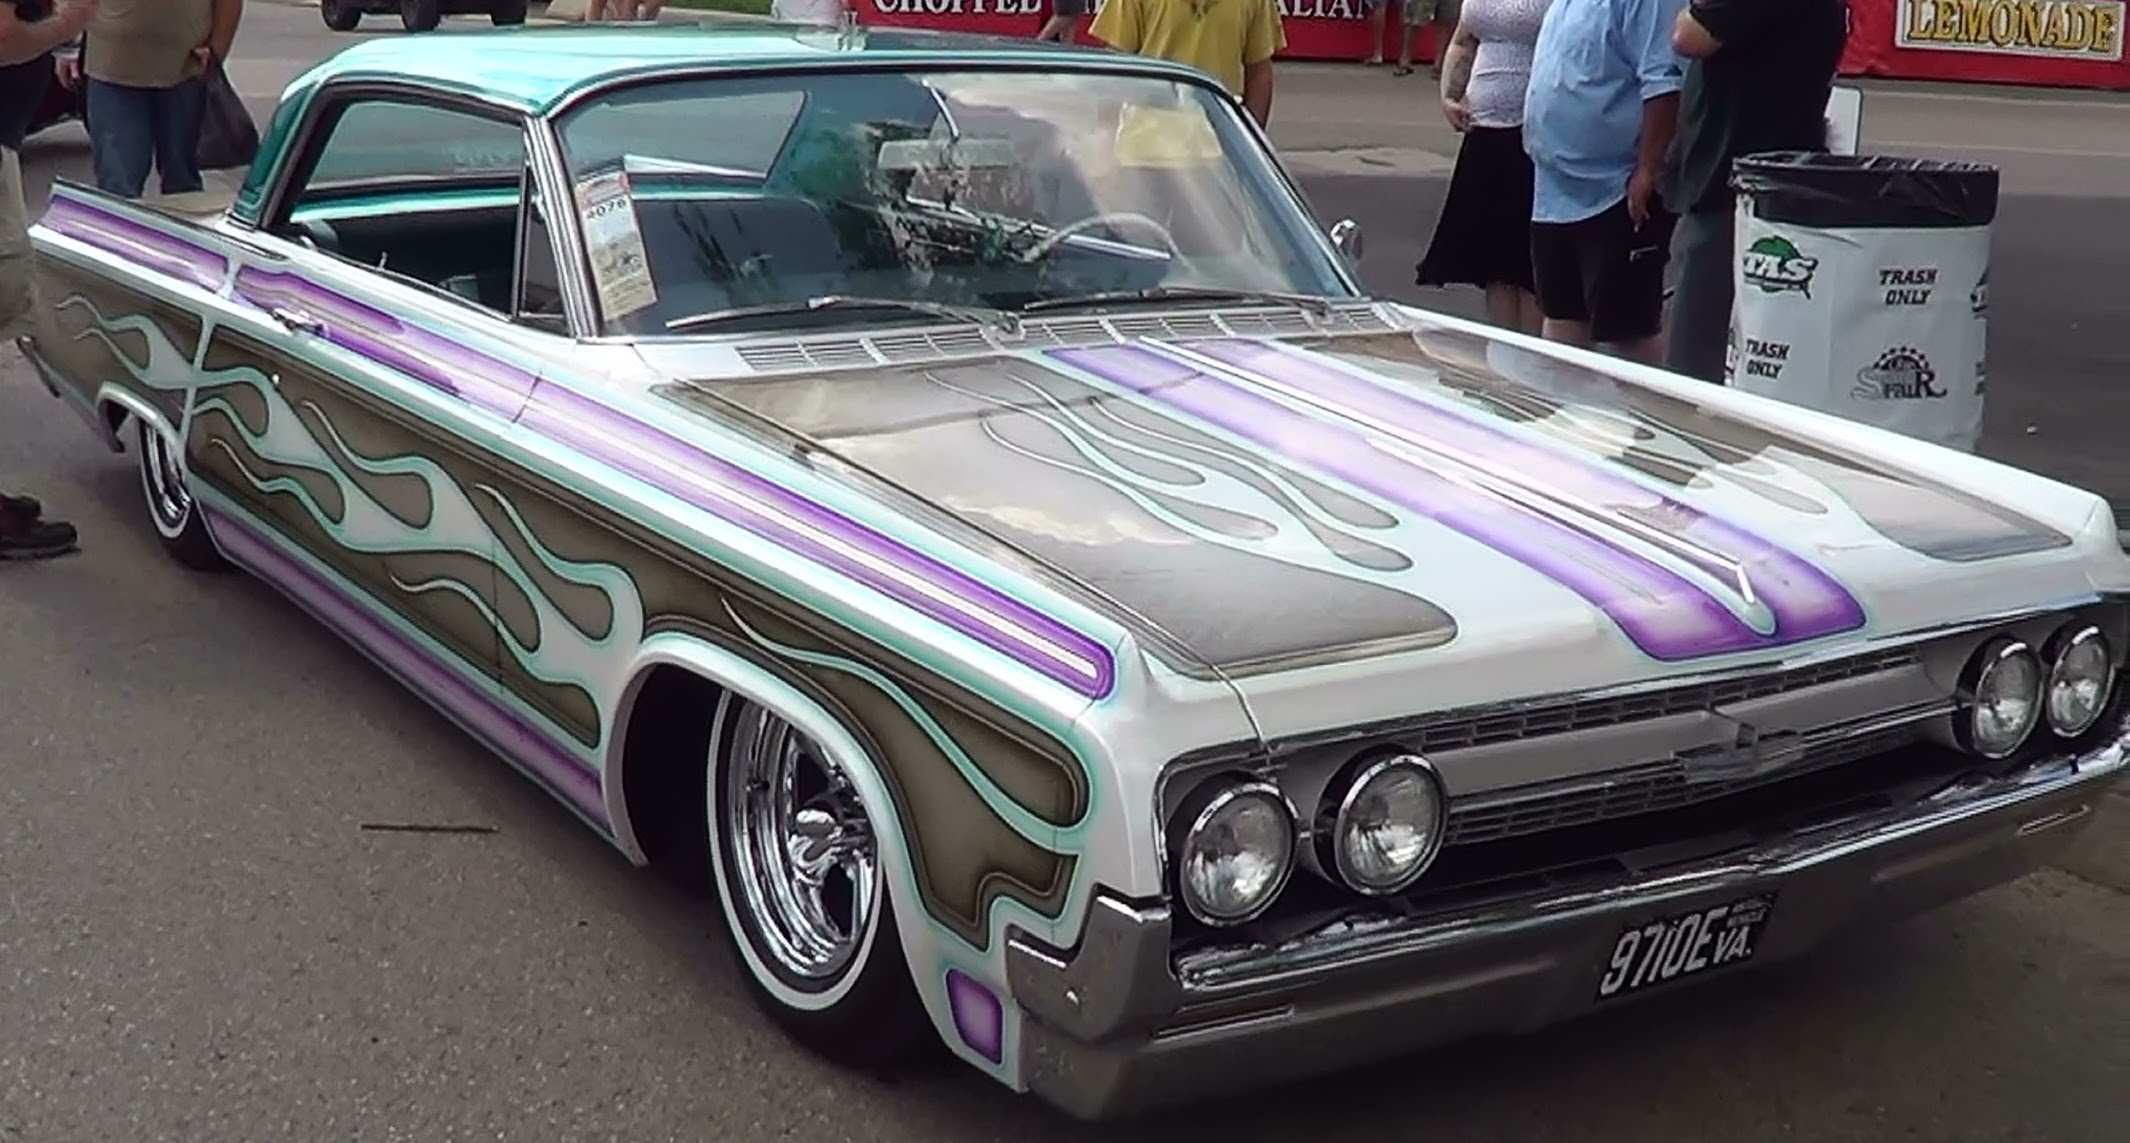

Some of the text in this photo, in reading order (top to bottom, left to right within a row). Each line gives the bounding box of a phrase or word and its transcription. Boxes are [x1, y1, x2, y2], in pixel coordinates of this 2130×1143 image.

[1907, 0, 2117, 53] LEMONADE
[1879, 268, 1939, 286] TRASH
[1885, 289, 1932, 306] ONLY
[1745, 338, 1791, 361] TRASH
[1746, 358, 1783, 380] ONLY
[1600, 905, 1730, 997] 9710E
